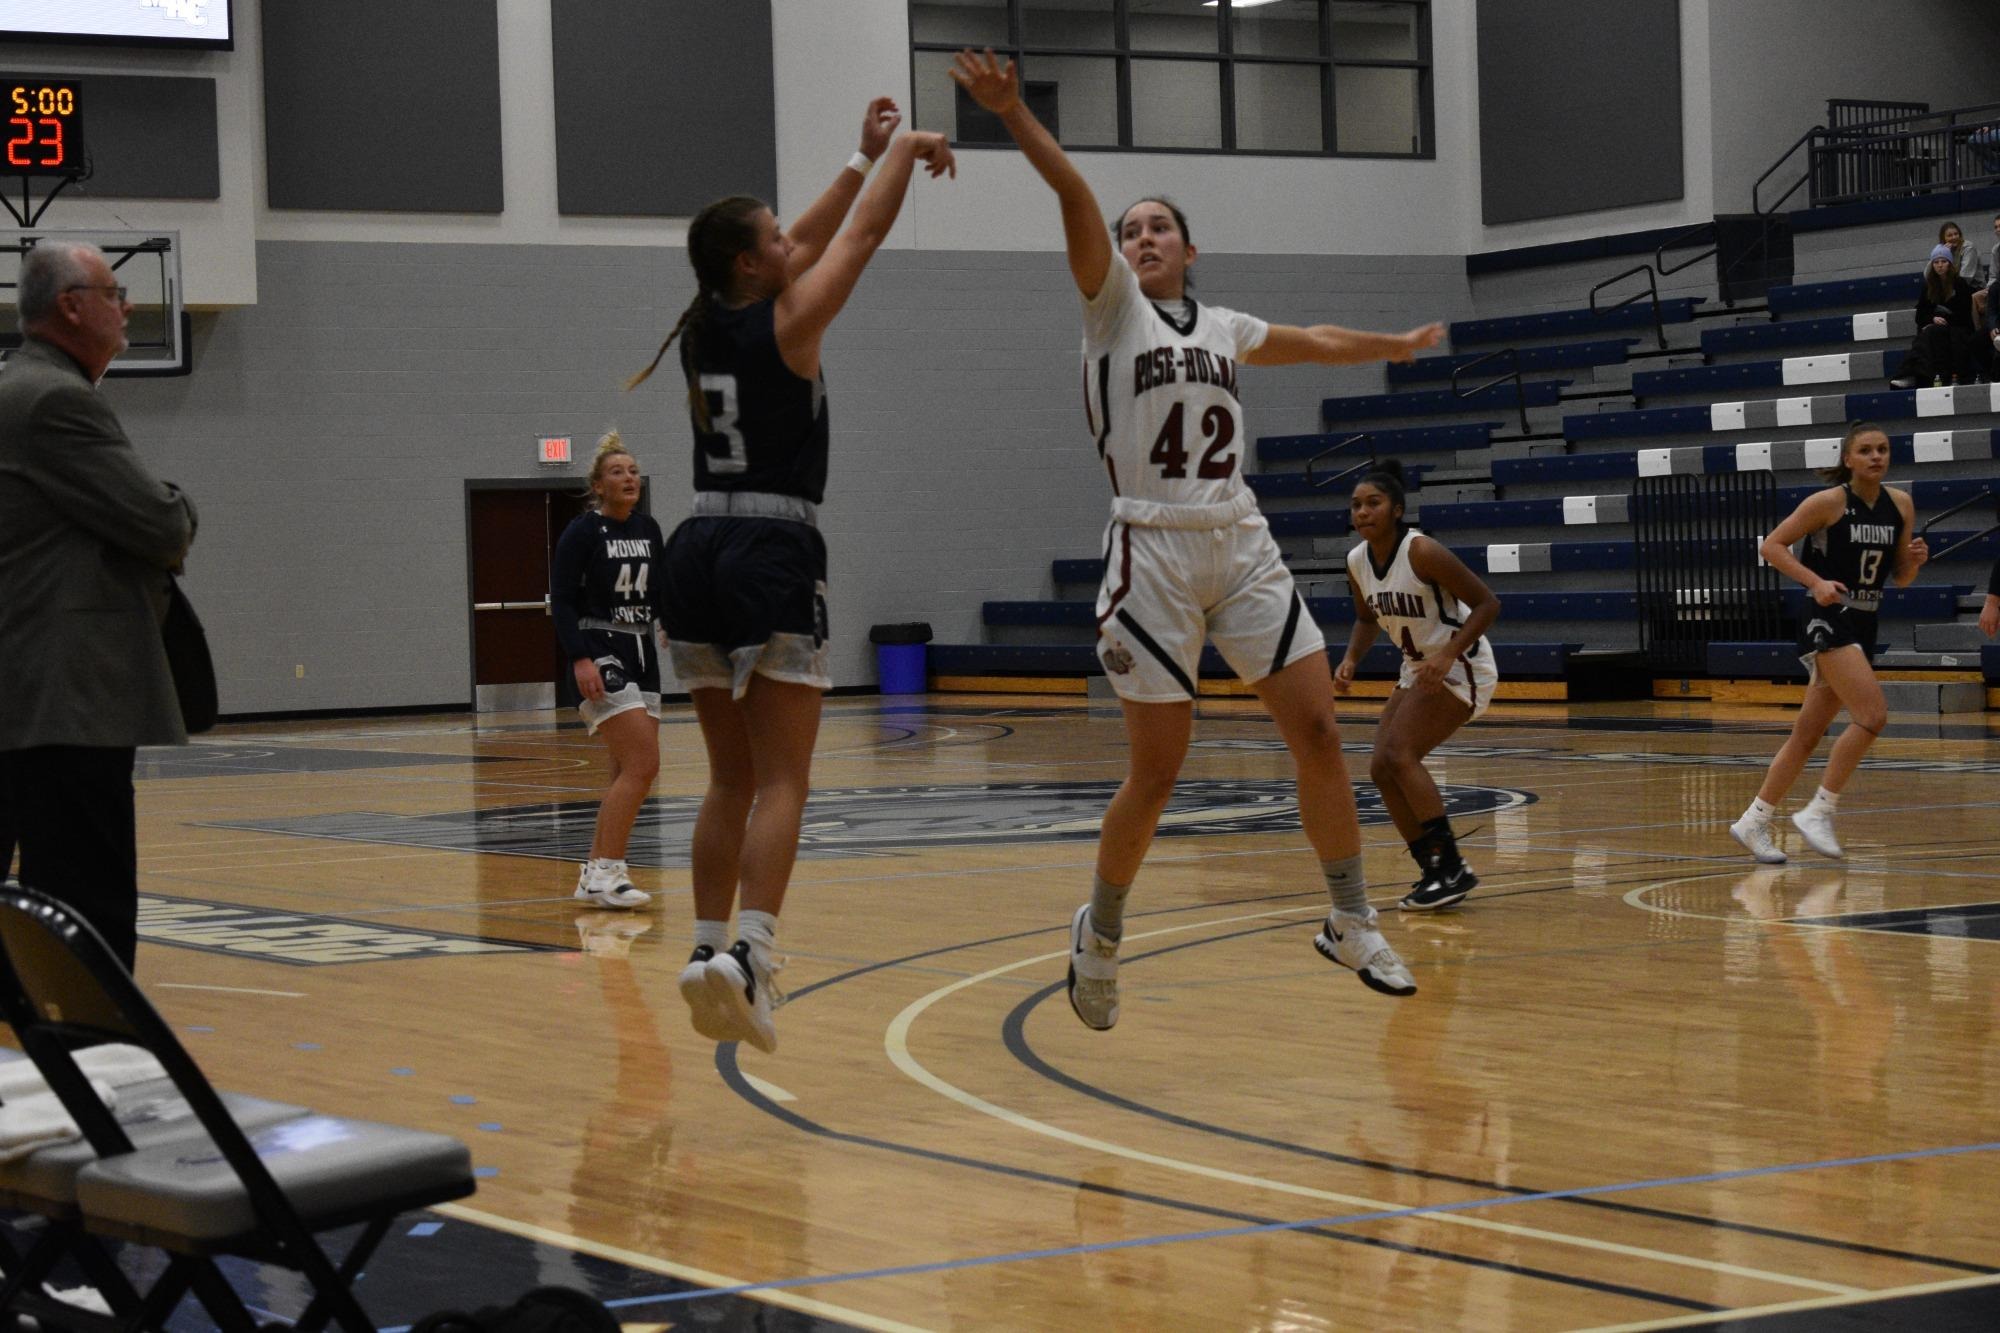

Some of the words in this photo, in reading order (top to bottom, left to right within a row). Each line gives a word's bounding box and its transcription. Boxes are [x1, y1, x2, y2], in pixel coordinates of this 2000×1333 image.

[12, 87, 73, 115] 5:00
[8, 117, 63, 165] 23
[699, 372, 748, 475] 3
[1150, 402, 1236, 479] 42
[545, 439, 568, 459] EXIT
[605, 539, 652, 559] MOUNT
[1850, 524, 1895, 545] MOUNT
[614, 562, 649, 600] 44
[1858, 549, 1884, 585] 13
